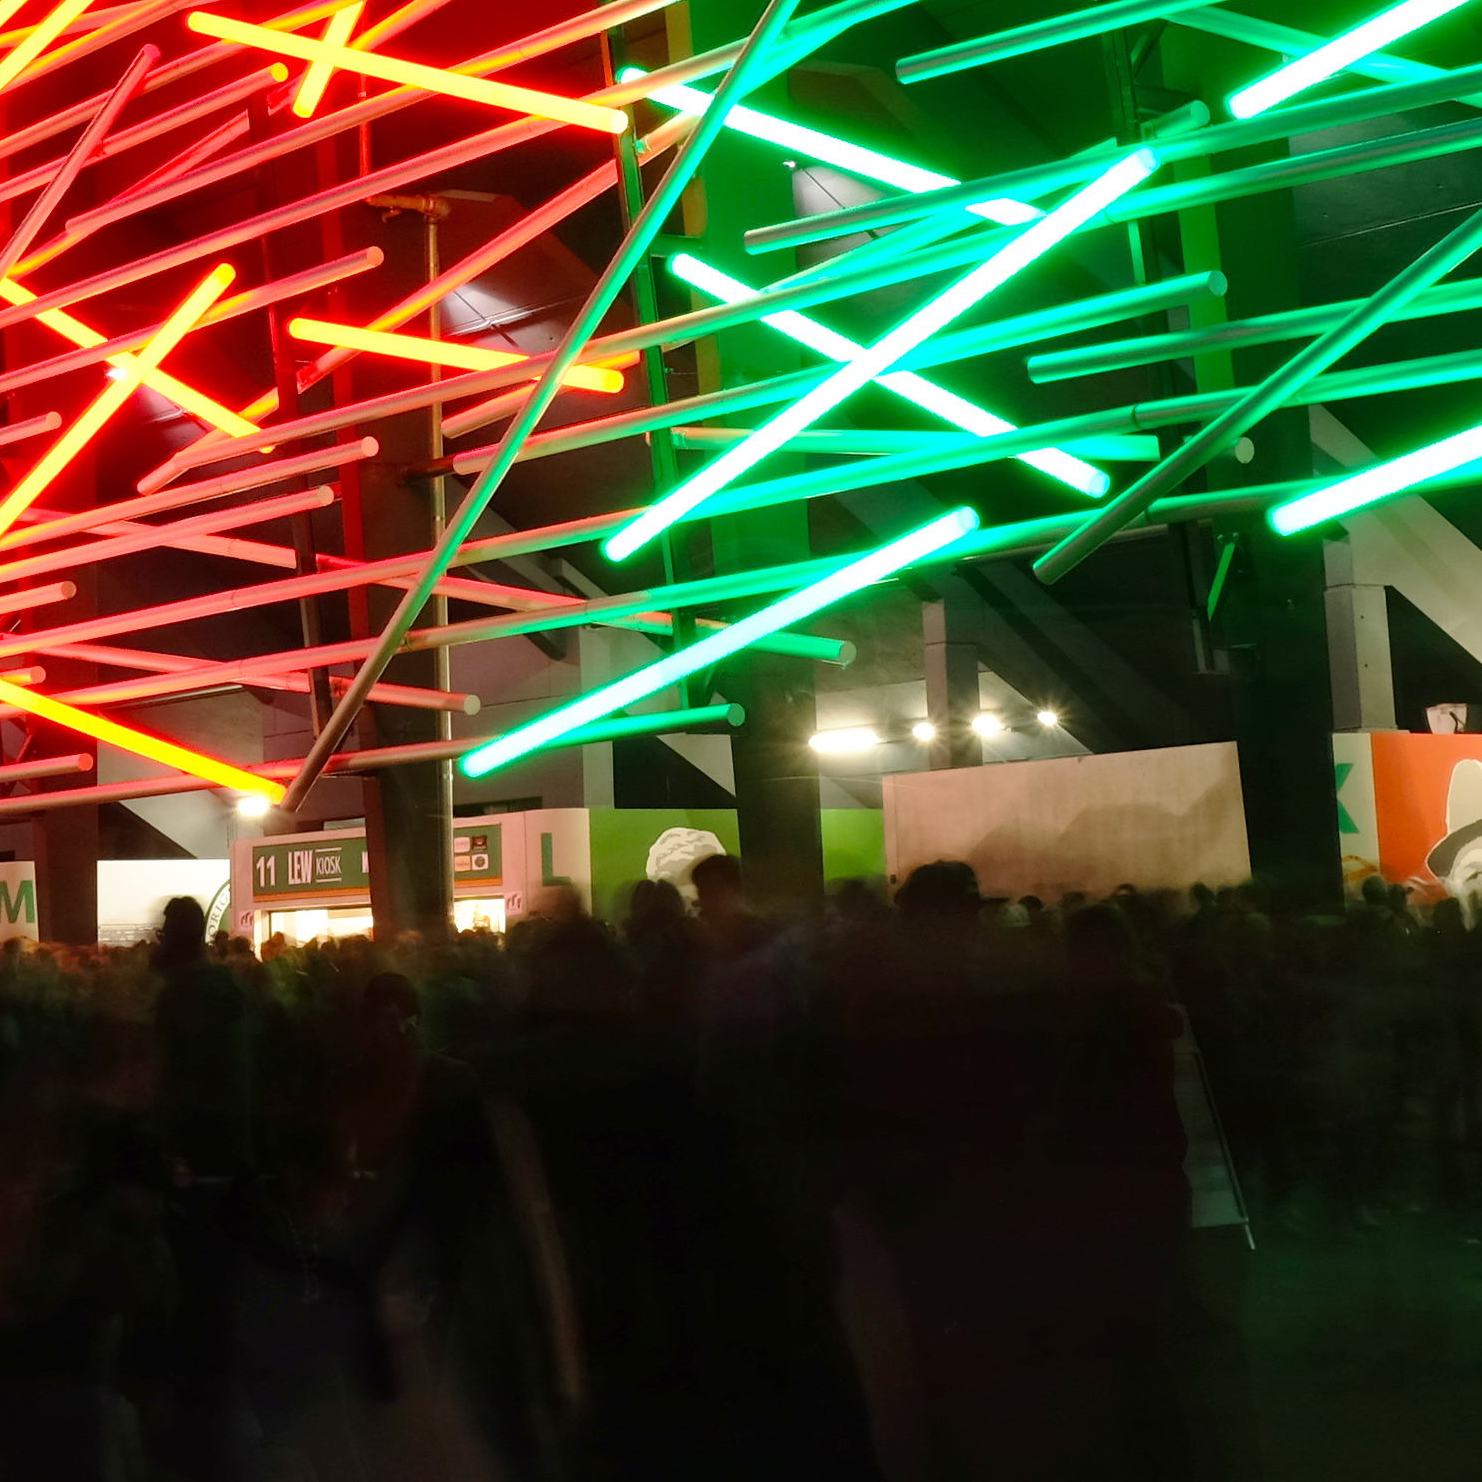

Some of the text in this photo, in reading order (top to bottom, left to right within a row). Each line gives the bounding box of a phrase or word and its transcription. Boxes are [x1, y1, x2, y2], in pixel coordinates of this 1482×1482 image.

[256, 855, 276, 887] 11
[287, 849, 314, 885] LEW
[315, 855, 342, 875] KIOSK
[540, 832, 572, 887] L
[207, 884, 231, 938] ORIG
